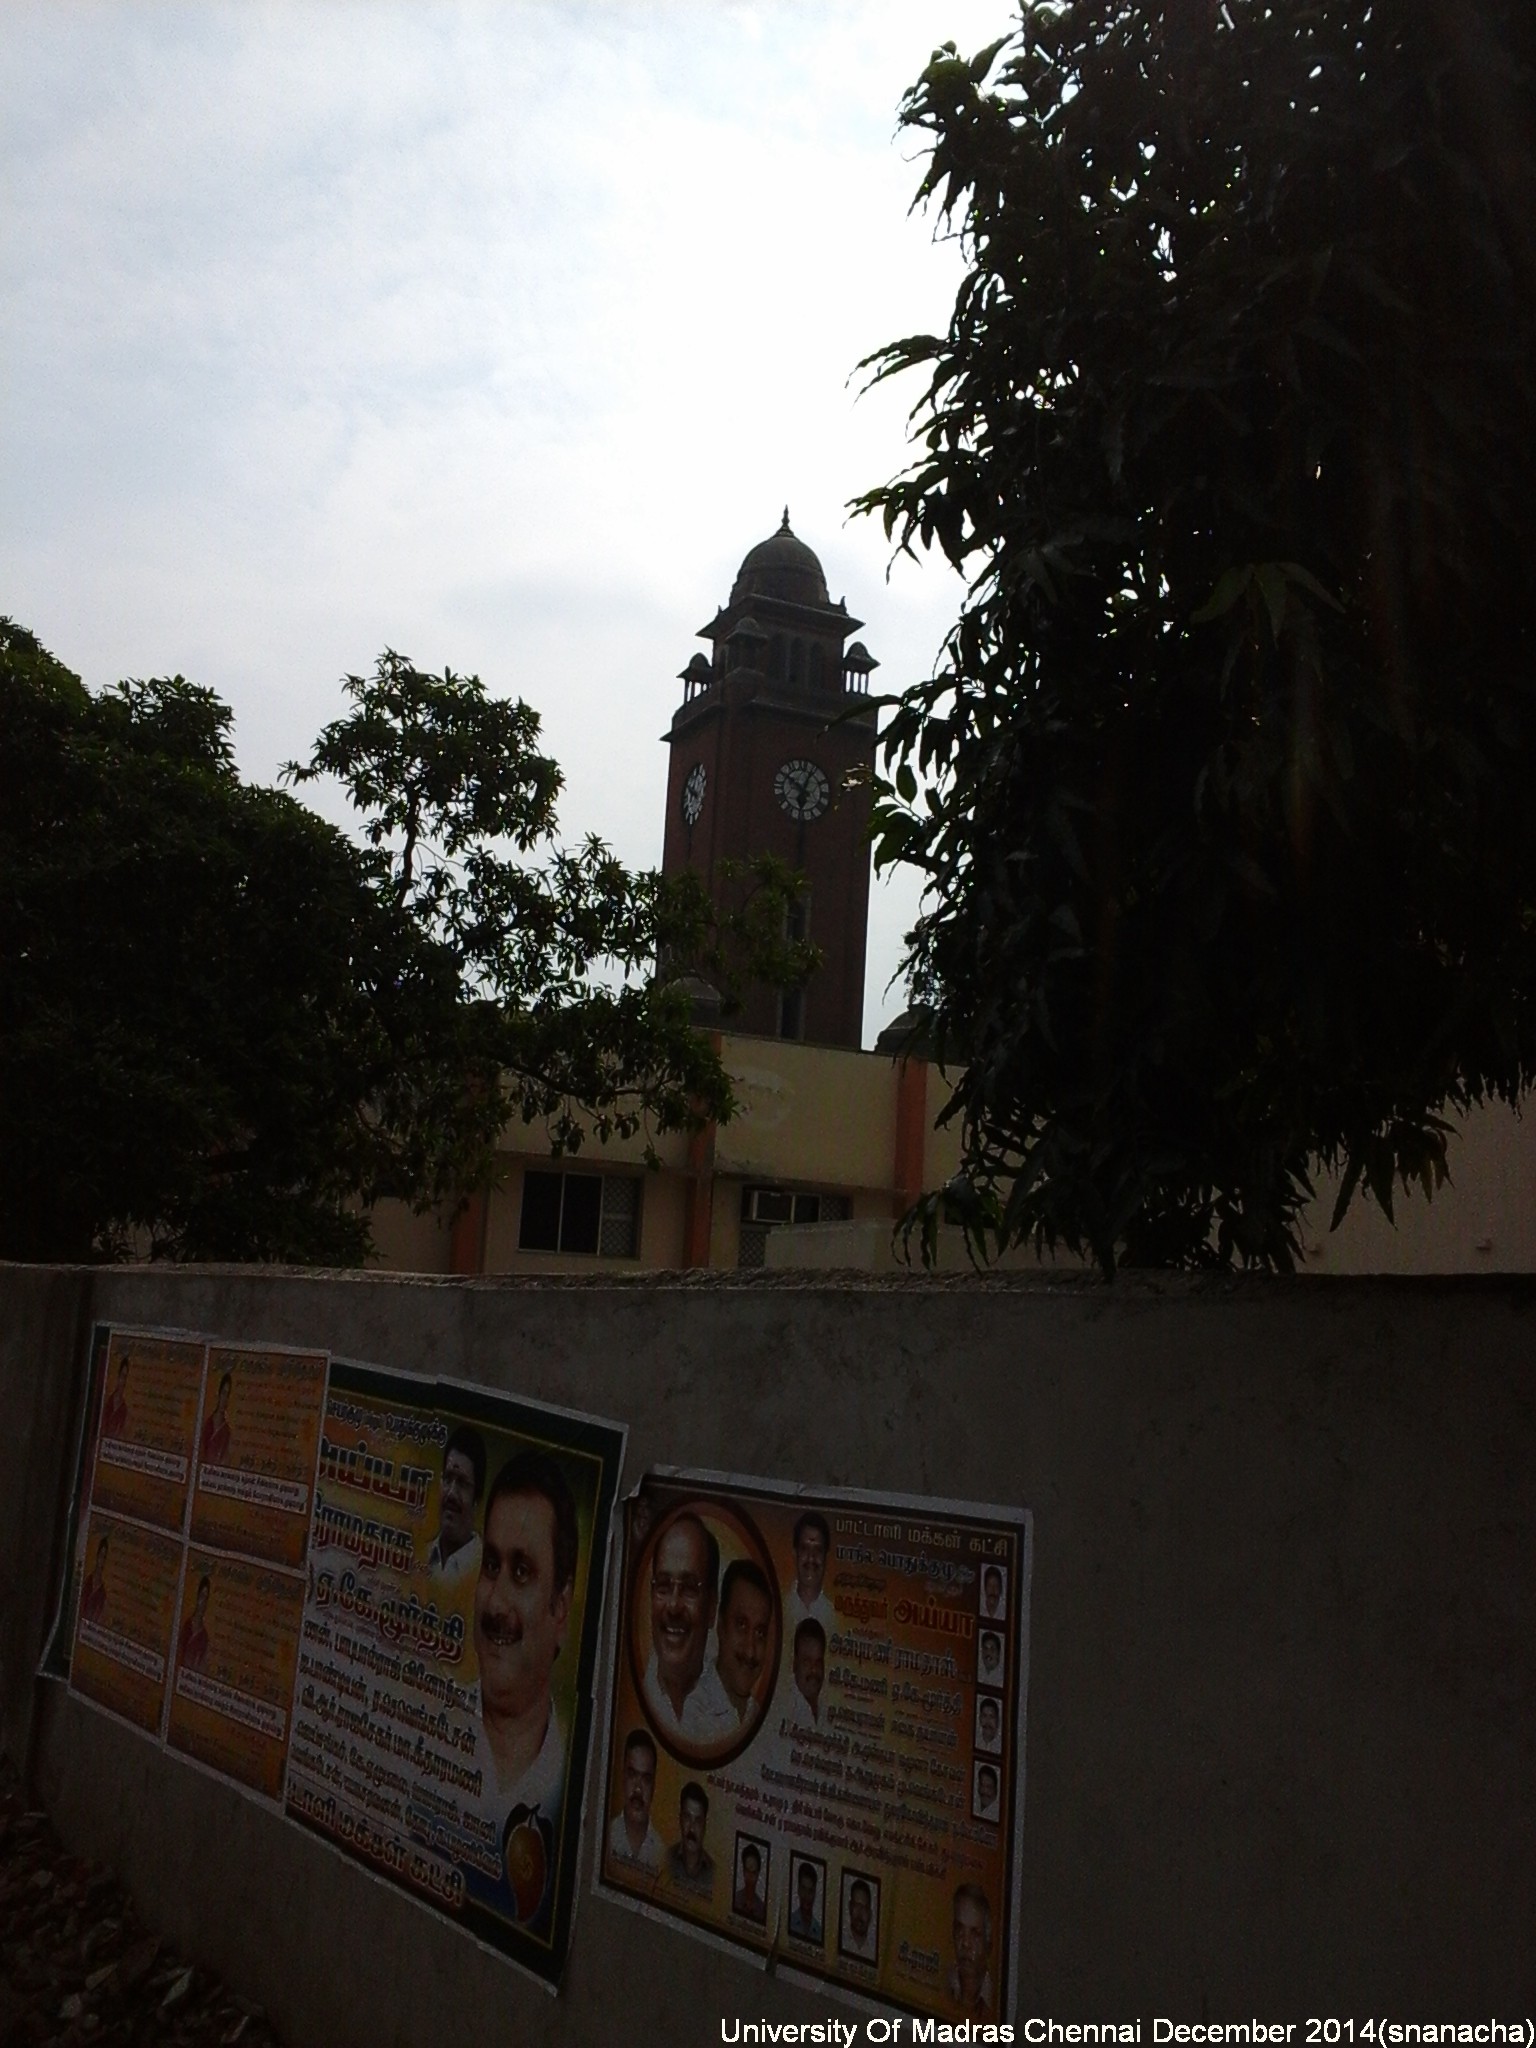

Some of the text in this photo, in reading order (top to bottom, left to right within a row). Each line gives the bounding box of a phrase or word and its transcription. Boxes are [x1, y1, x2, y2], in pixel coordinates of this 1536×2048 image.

[836, 1519, 1008, 1557] பாட்டாளி மக்கள் கட்சி
[893, 1595, 975, 1639] அய்யா
